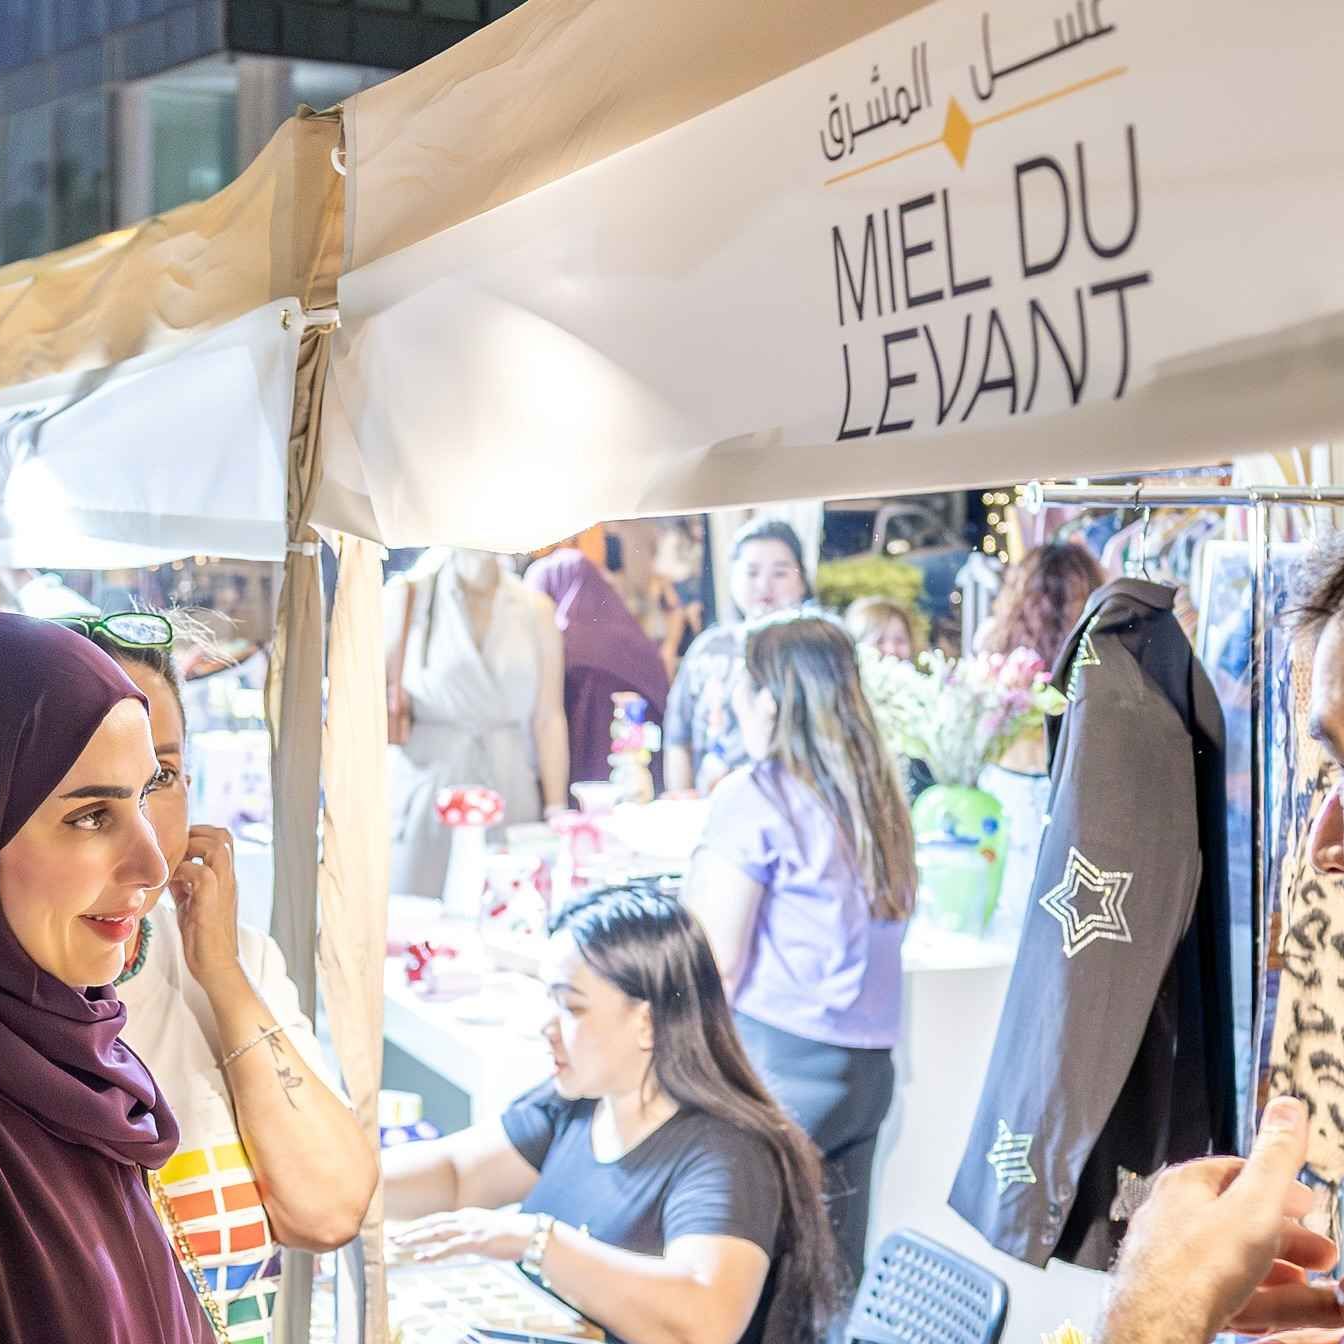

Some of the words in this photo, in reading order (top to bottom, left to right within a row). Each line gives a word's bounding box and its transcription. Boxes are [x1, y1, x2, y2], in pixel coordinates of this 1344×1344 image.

[820, 40, 932, 162] المشرق
[831, 187, 992, 327] MIEL
[1014, 122, 1143, 279] DU
[835, 271, 1153, 441] LEVANT
